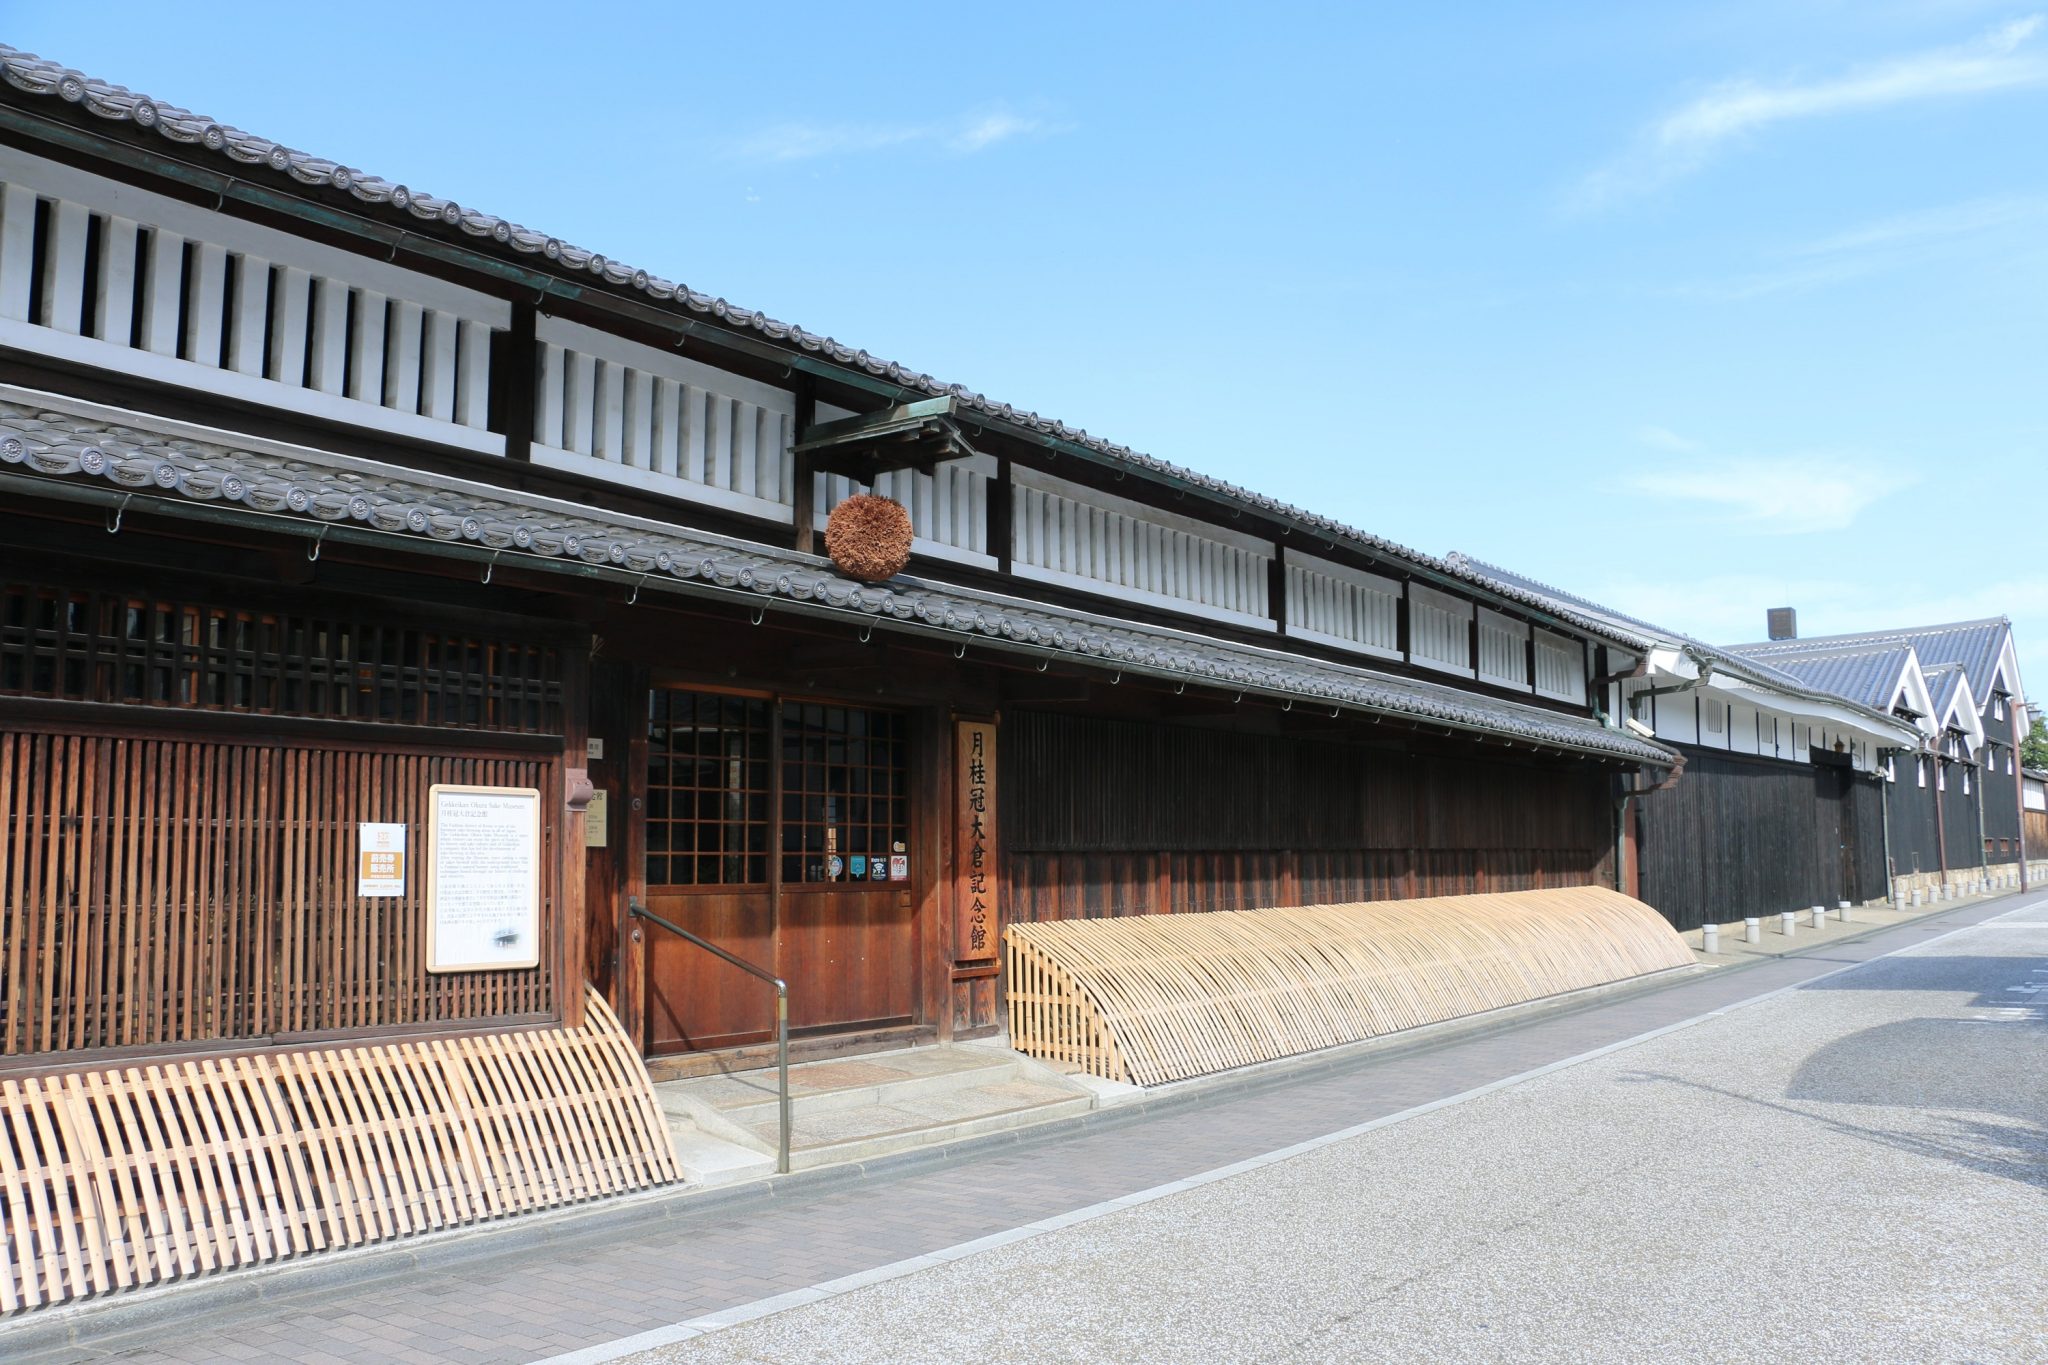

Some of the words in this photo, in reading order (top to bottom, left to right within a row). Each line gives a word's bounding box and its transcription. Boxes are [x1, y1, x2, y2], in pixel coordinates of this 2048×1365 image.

[968, 731, 987, 952] 月桂冠大倉記念館
